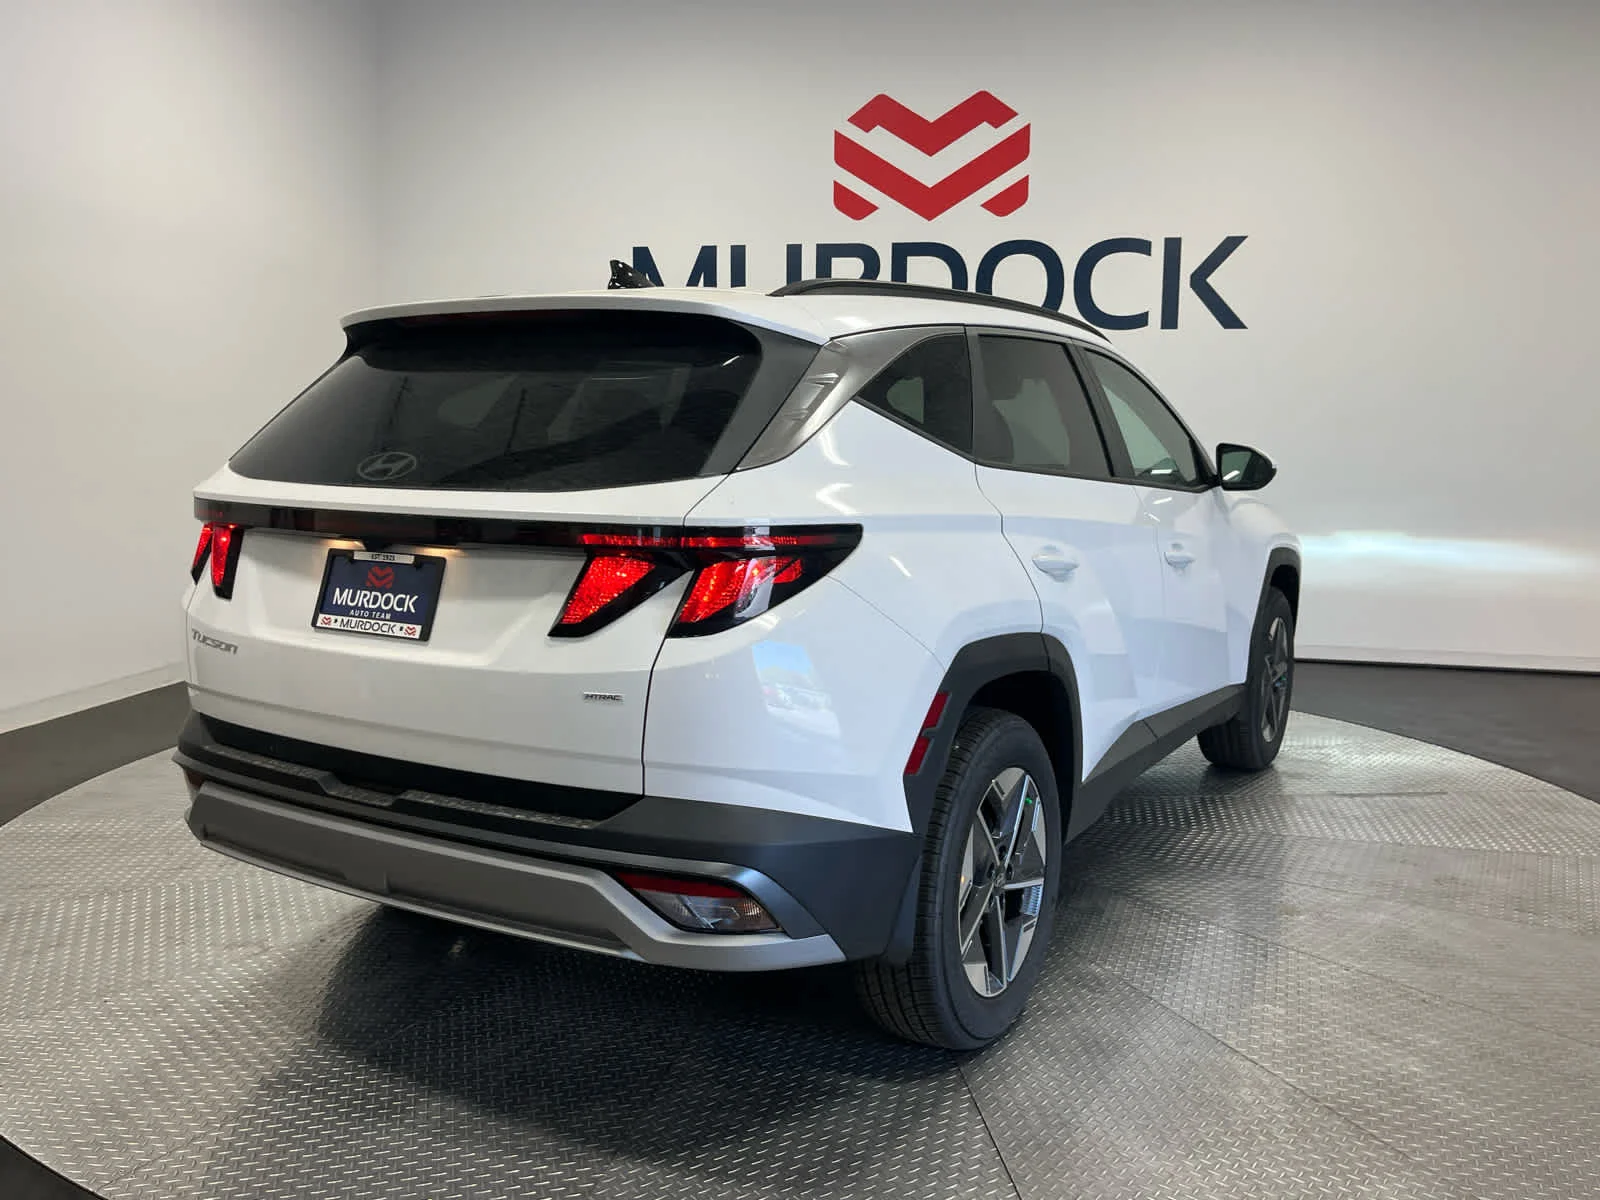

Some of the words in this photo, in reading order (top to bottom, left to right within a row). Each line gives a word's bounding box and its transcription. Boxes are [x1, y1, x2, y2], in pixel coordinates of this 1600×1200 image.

[332, 587, 418, 613] MURDOCK
[349, 609, 370, 618] AUTO
[372, 611, 391, 620] TEAM
[339, 617, 396, 634] MURDOCK
[192, 628, 239, 655] TUCSON
